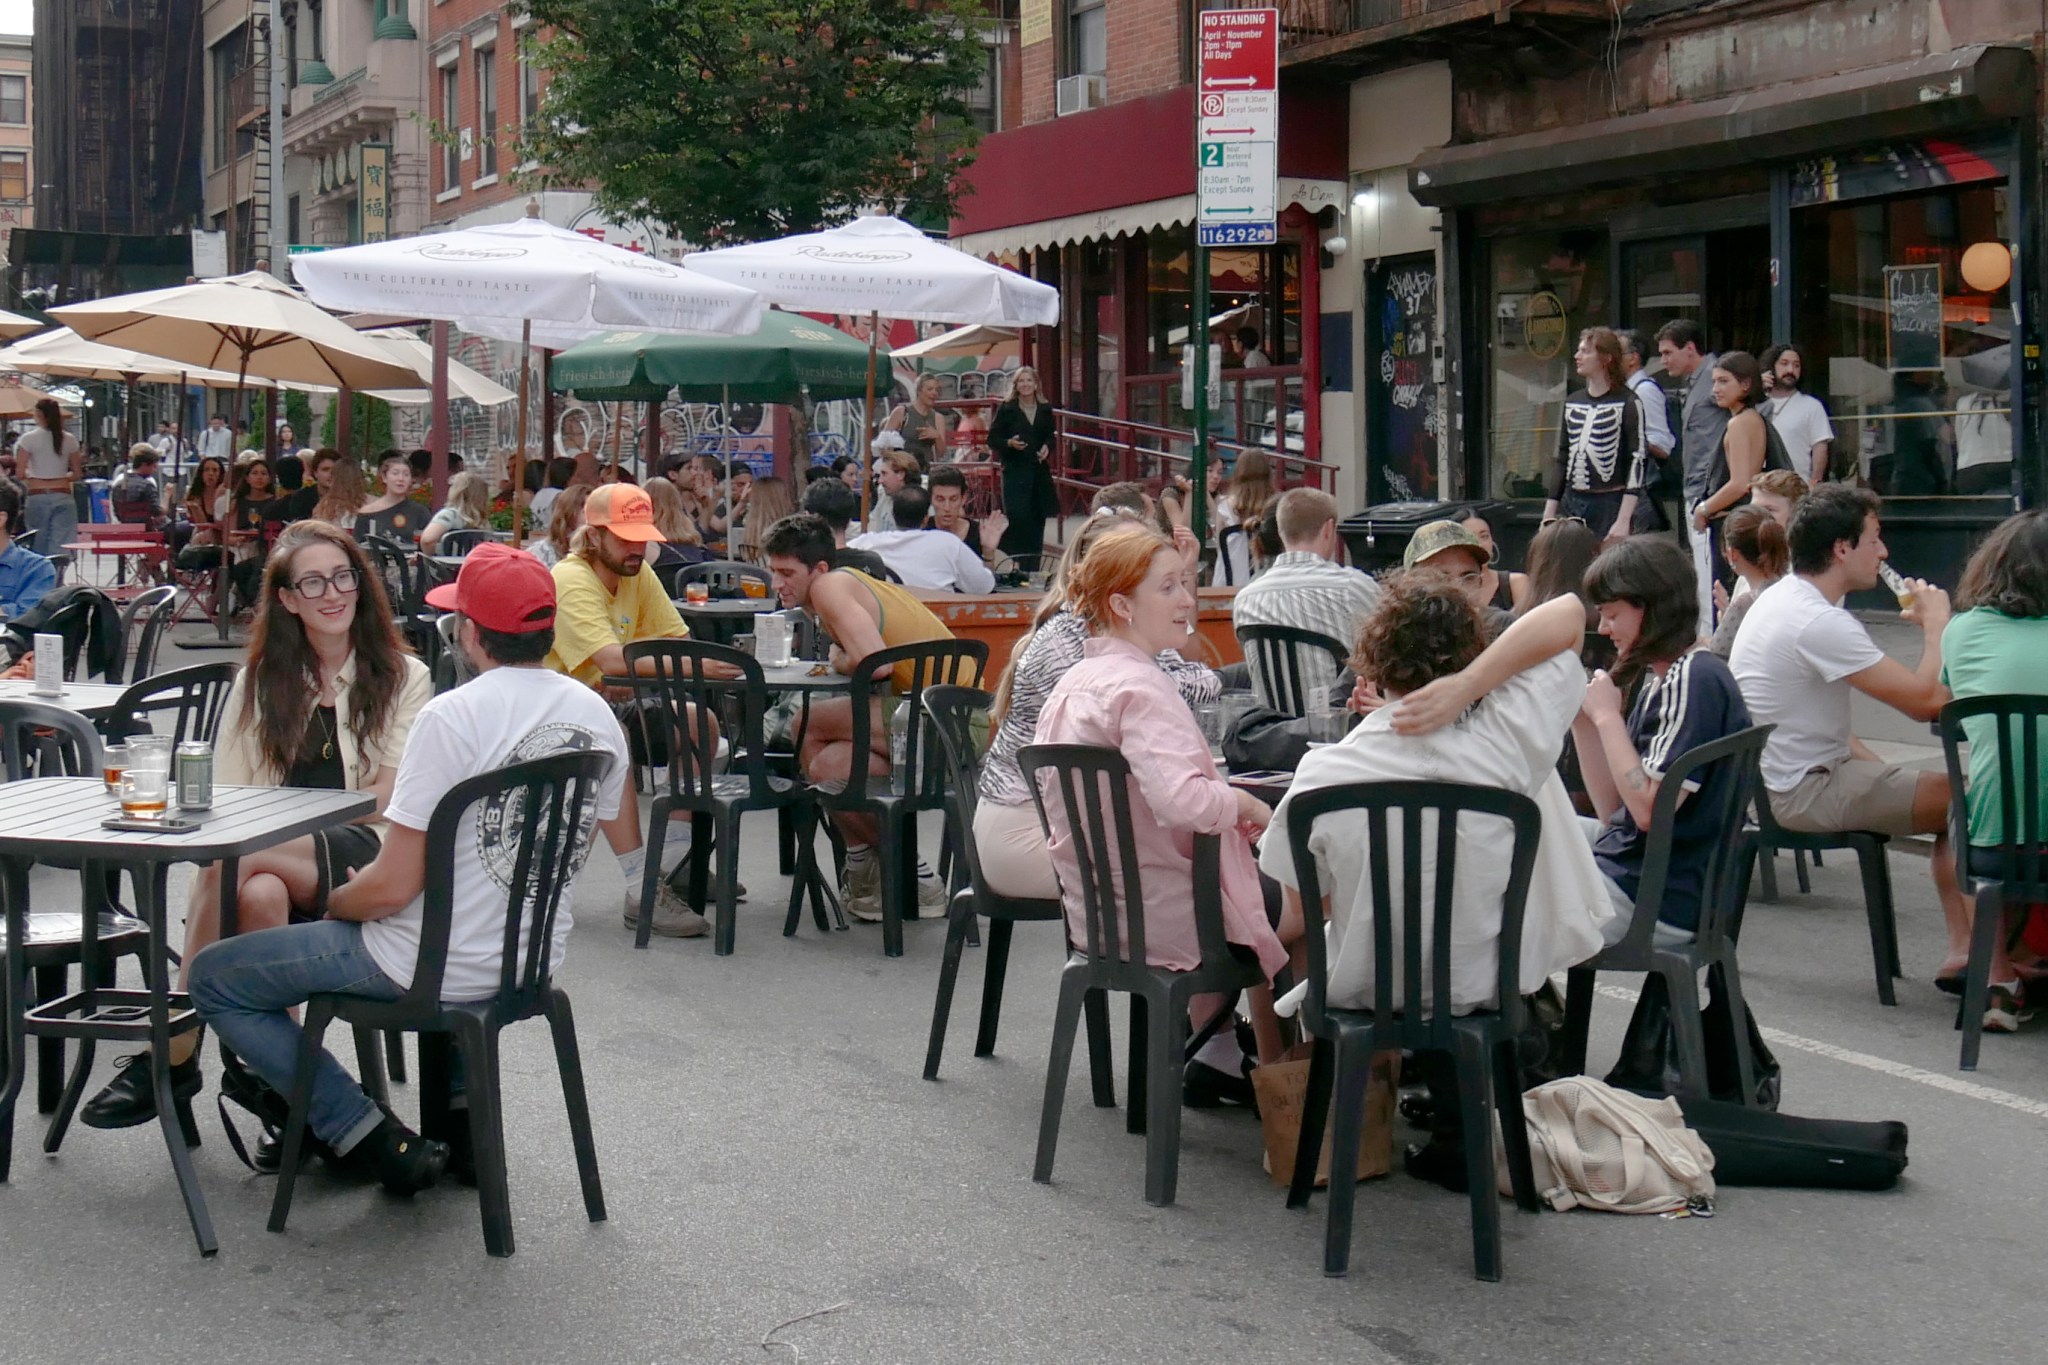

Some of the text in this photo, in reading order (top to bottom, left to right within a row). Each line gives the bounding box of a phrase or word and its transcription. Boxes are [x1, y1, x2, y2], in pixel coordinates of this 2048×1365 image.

[1204, 13, 1266, 26] NO STANDING
[1204, 31, 1221, 41] April
[1227, 30, 1262, 39] November
[1204, 41, 1220, 50] 3pm
[1226, 41, 1242, 50] 11pm
[1204, 51, 1232, 60] All Days
[1247, 105, 1269, 113] Sunday
[1206, 144, 1219, 166] 2
[1203, 176, 1230, 184] 8:30am
[1236, 175, 1251, 184] 7pm
[1203, 185, 1255, 194] Except Sunday
[1201, 228, 1257, 243] 116292
[343, 272, 370, 281] THE
[381, 274, 446, 286] CULTURE
[457, 280, 473, 288] OF
[741, 271, 768, 279] THE
[779, 272, 848, 282] CULTURE
[1405, 293, 1421, 316] 37
